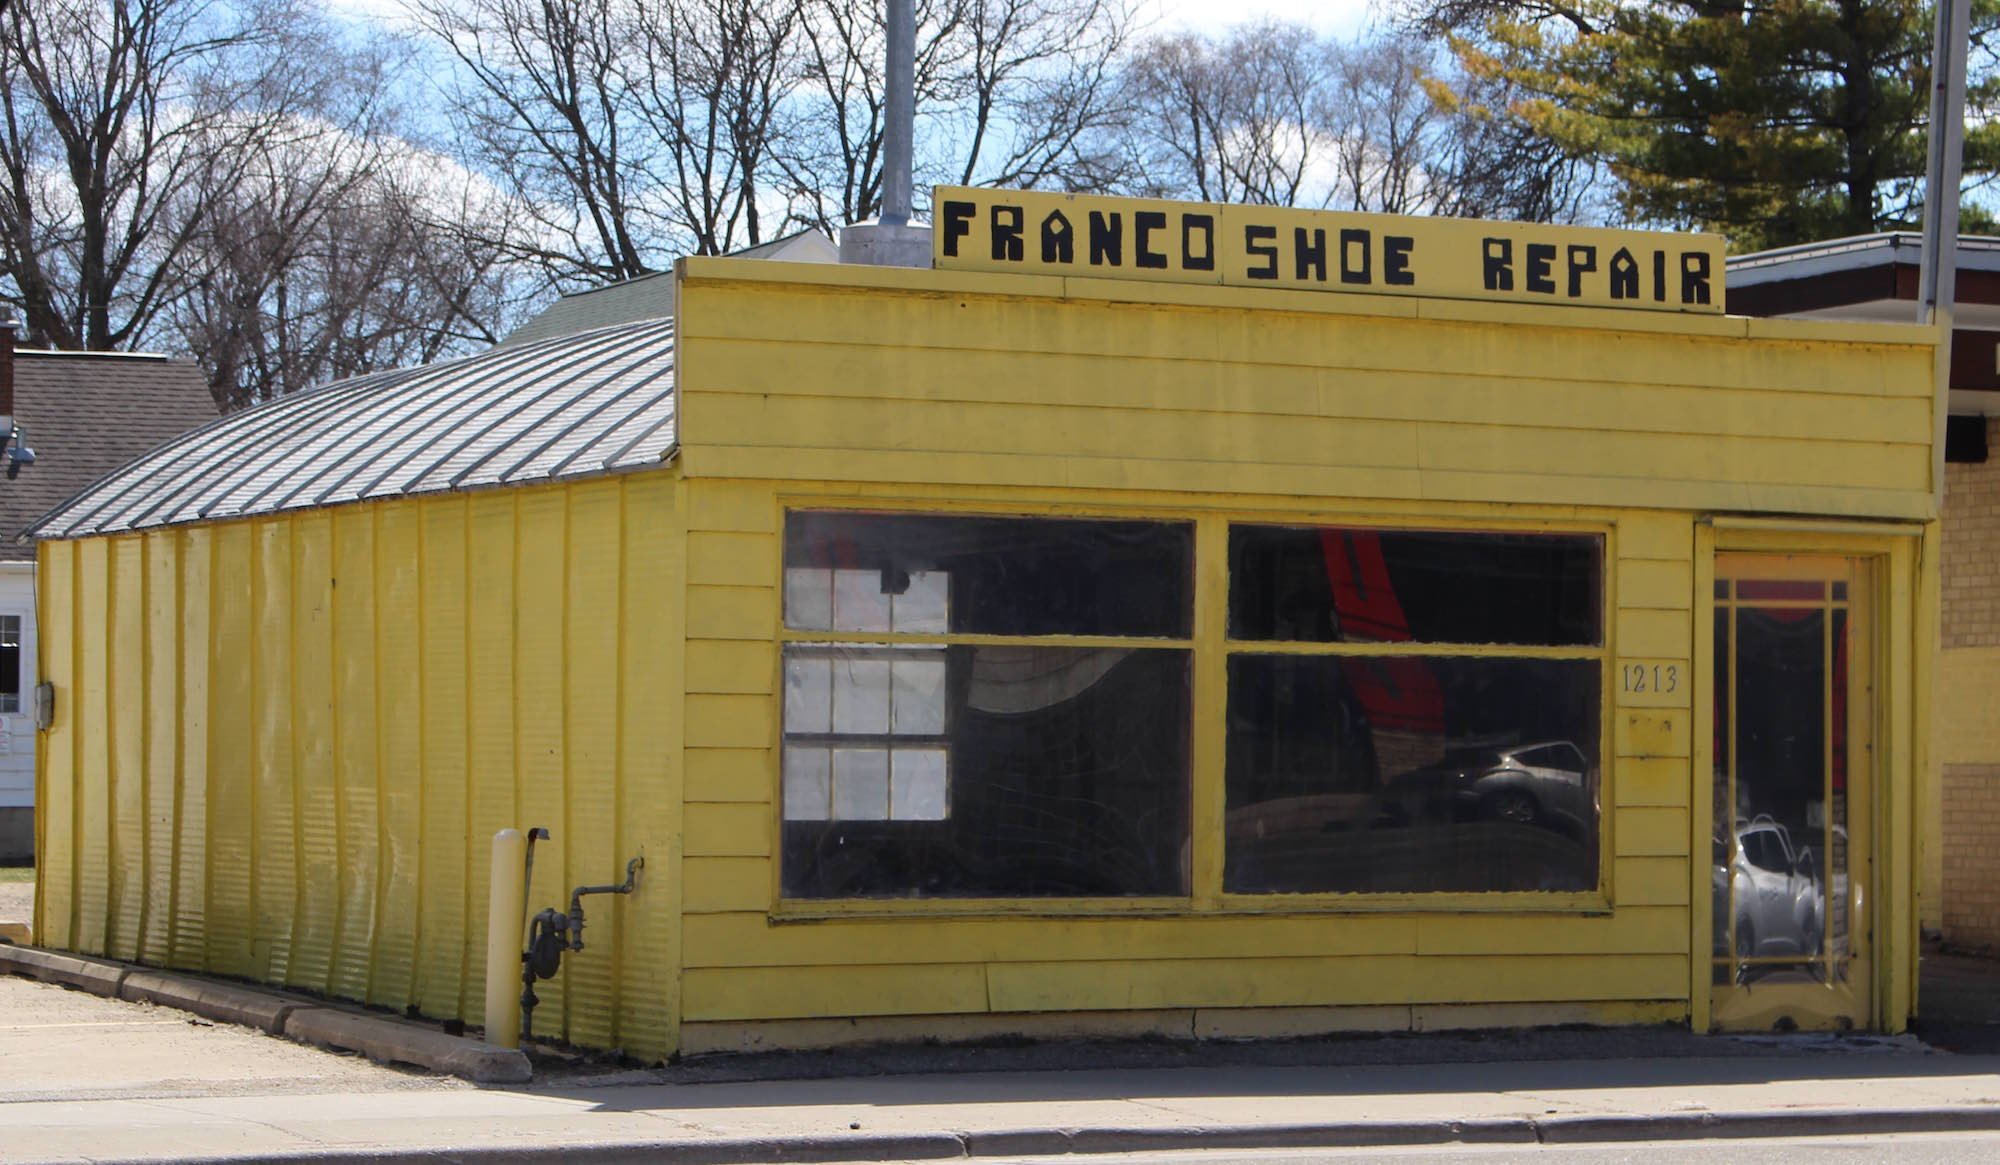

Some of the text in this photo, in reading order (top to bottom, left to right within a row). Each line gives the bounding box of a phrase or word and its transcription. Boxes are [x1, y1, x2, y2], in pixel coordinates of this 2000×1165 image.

[942, 200, 1711, 306] FRANCO SHOE REPAIR
[1623, 664, 1677, 693] 1213
